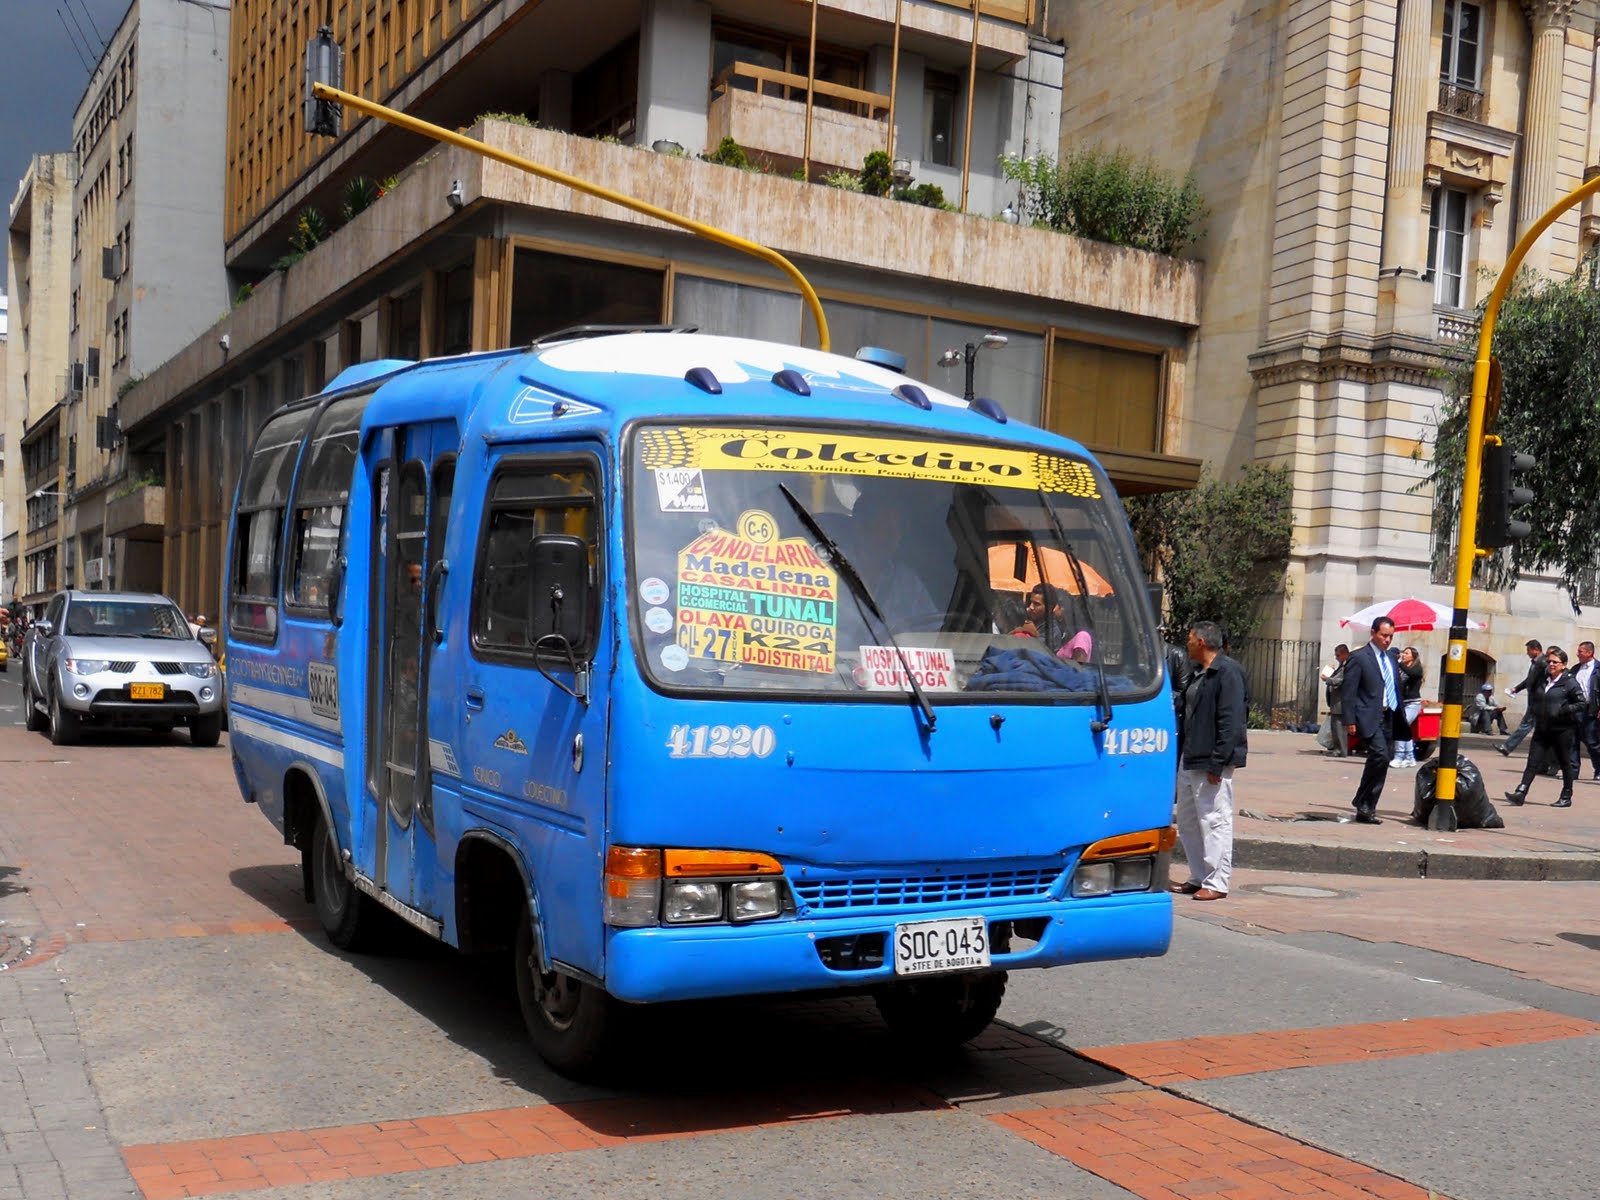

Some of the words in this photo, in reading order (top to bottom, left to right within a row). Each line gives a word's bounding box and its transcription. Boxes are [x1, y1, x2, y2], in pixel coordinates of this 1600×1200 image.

[696, 429, 787, 440] Servicio
[720, 439, 1023, 477] Colectivo
[804, 464, 868, 474] Admiten
[878, 469, 946, 480] Pasajeros
[747, 521, 769, 538] C-6
[689, 534, 828, 570] CANDELARIA
[685, 553, 831, 588] Madelena
[680, 571, 834, 600] CASALINDA
[680, 583, 748, 603] HOSPITAL
[680, 595, 748, 613] C.COMERCIAL
[749, 592, 833, 625] TUNAL
[679, 609, 747, 631] OLAYA
[750, 617, 833, 641] QUIROGA
[702, 627, 732, 660] 27
[742, 646, 833, 673] U.DISTRITAL
[864, 648, 914, 670] HOSPITAL
[915, 651, 950, 672] TUNAL
[665, 724, 776, 759] 41220
[1103, 727, 1169, 755] 41220
[899, 929, 940, 961] SDC
[945, 925, 985, 956] 043
[912, 960, 932, 971] STFE
[934, 959, 944, 969] DE
[946, 956, 975, 967] BOGOTA
